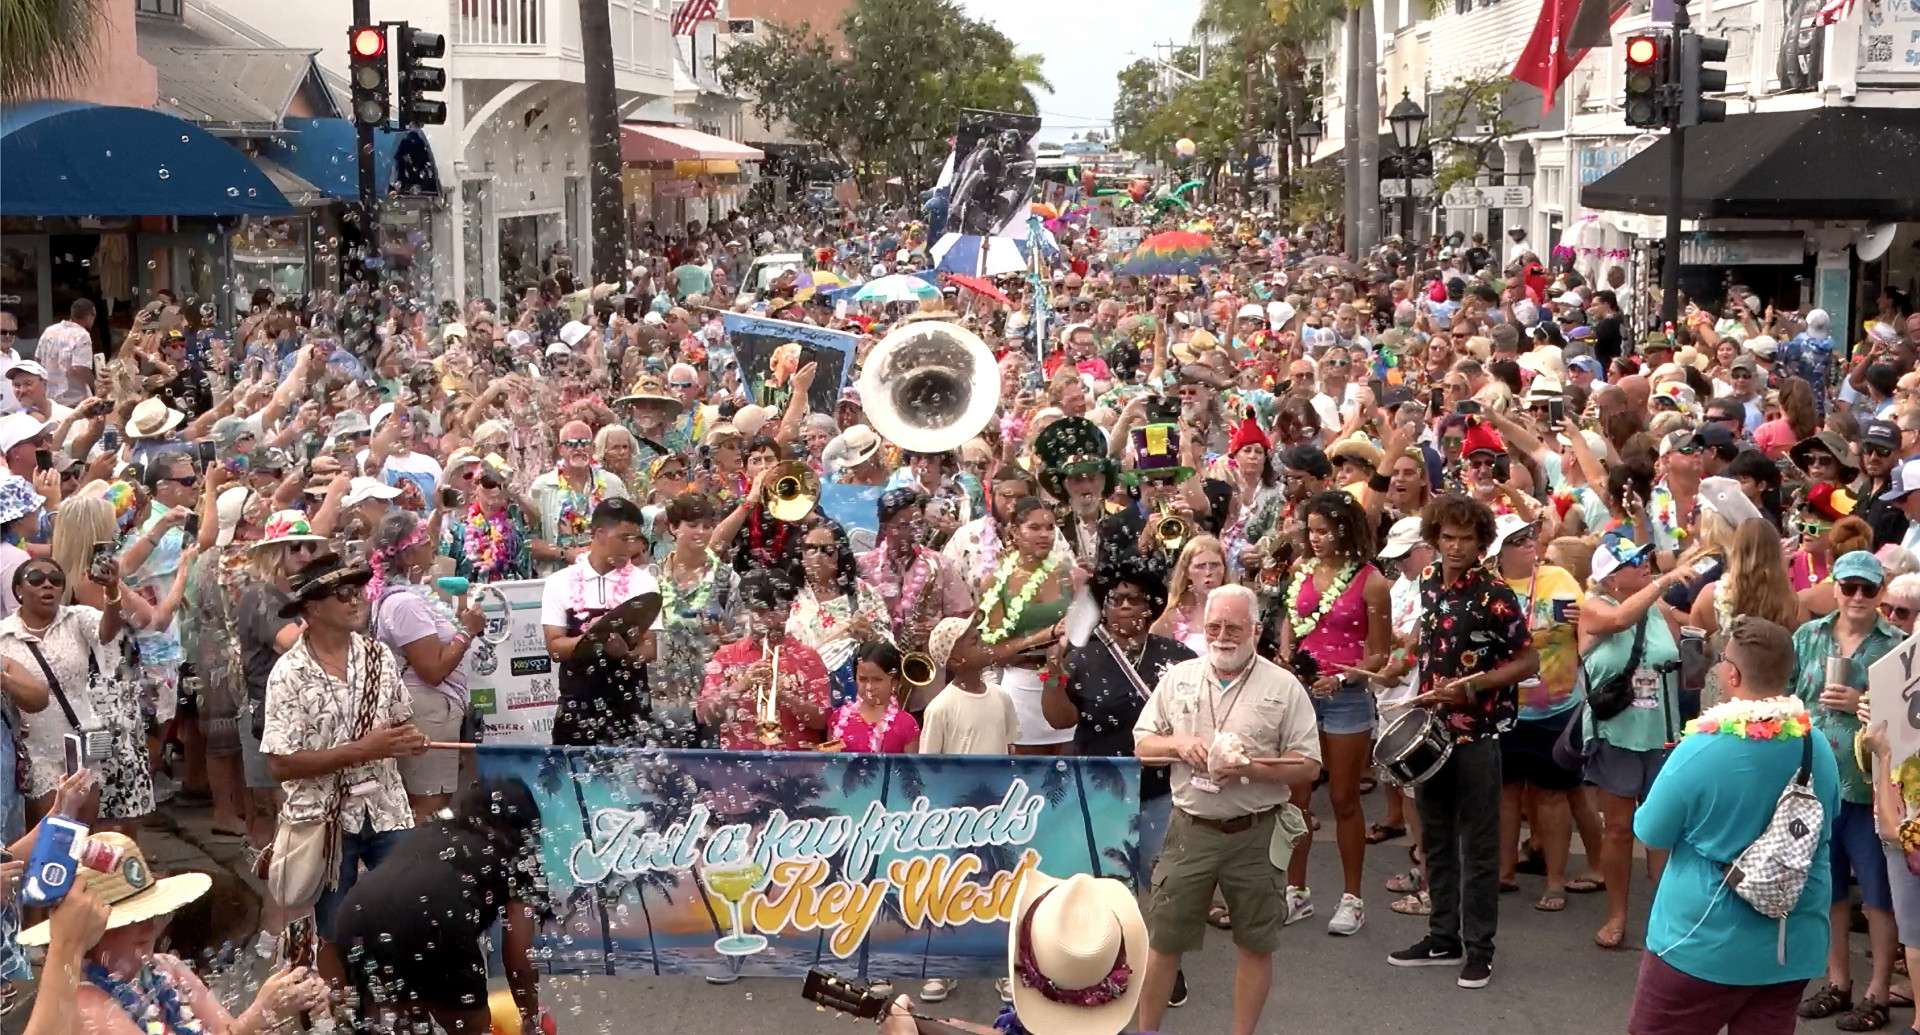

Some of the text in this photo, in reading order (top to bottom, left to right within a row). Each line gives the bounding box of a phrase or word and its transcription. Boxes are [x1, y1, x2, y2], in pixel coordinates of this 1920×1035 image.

[570, 778, 1045, 892] Just a few friends
[751, 848, 1042, 960] Key West
